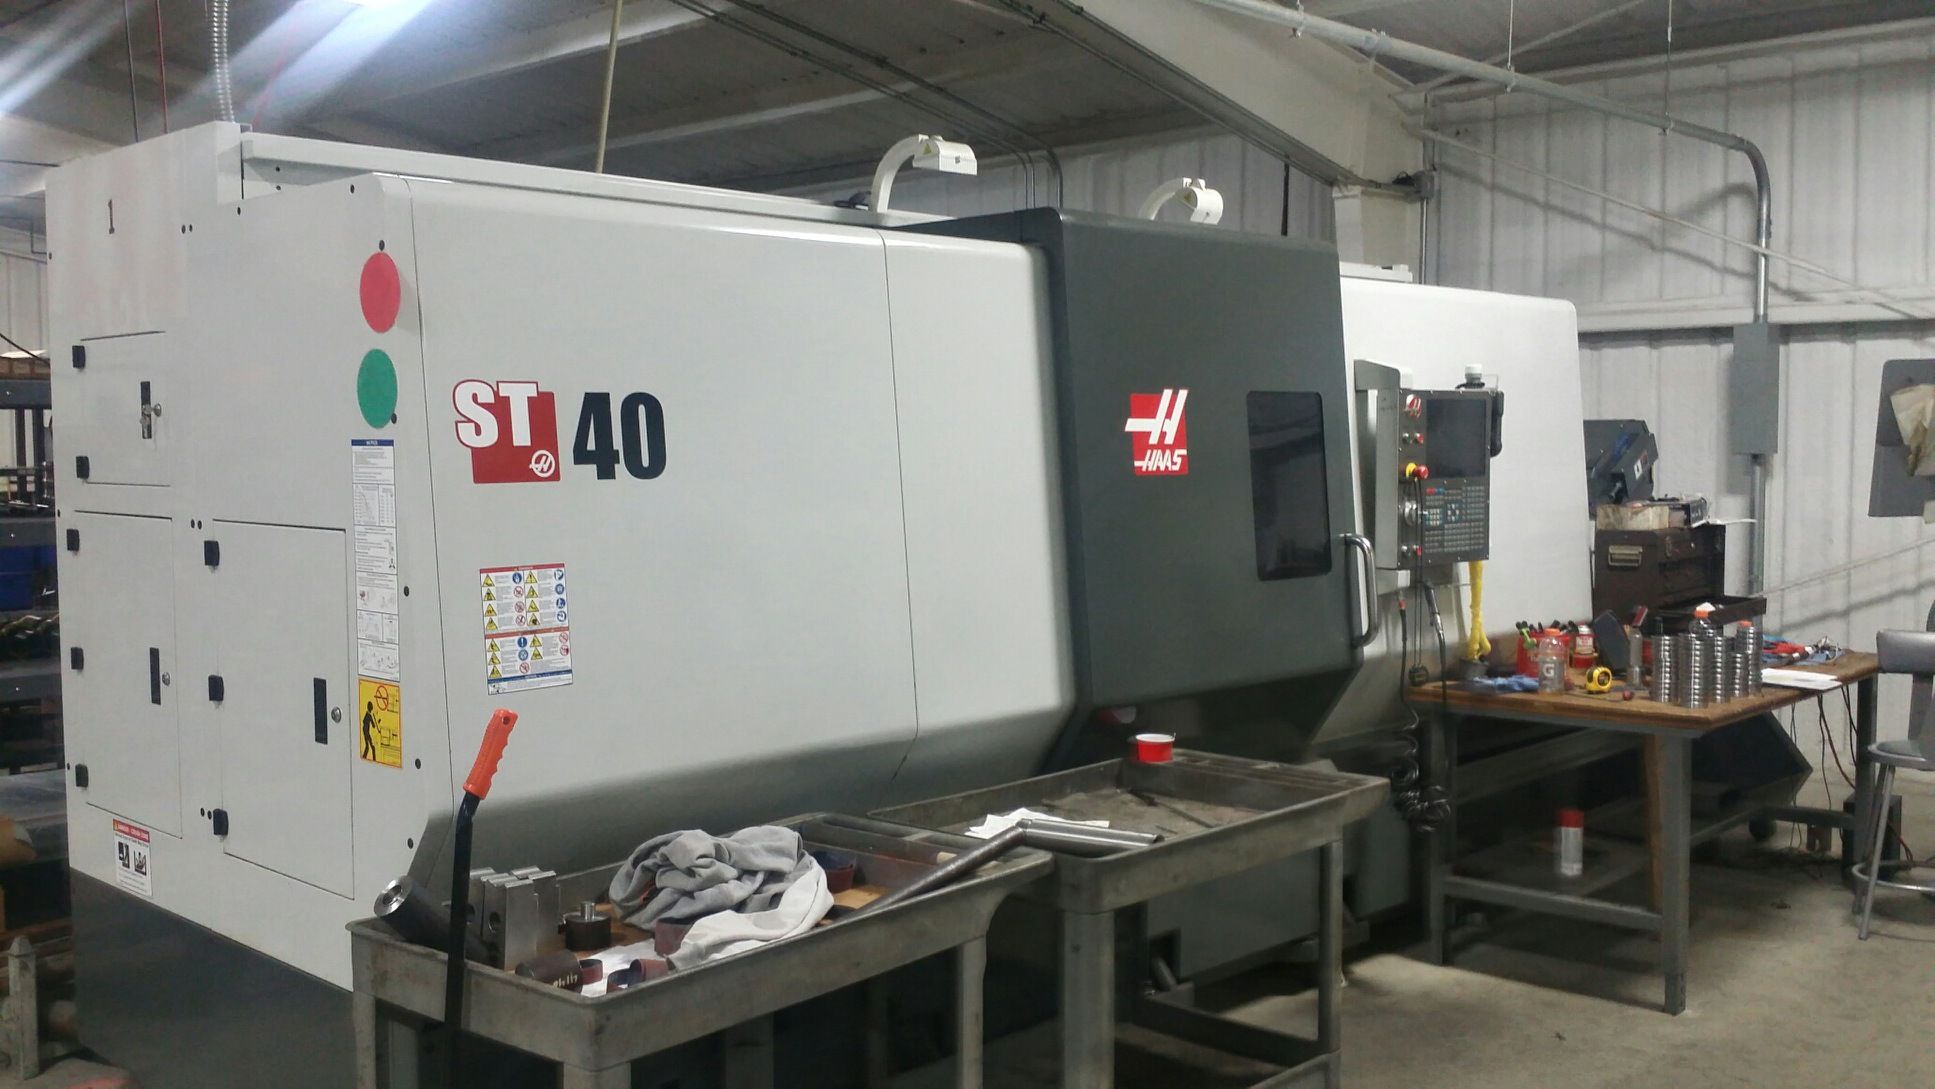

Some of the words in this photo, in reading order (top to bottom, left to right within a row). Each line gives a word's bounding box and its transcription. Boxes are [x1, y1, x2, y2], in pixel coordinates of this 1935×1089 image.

[453, 379, 538, 448] ST
[573, 391, 667, 480] 40
[1134, 449, 1187, 471] HAAS
[1543, 664, 1555, 677] G
